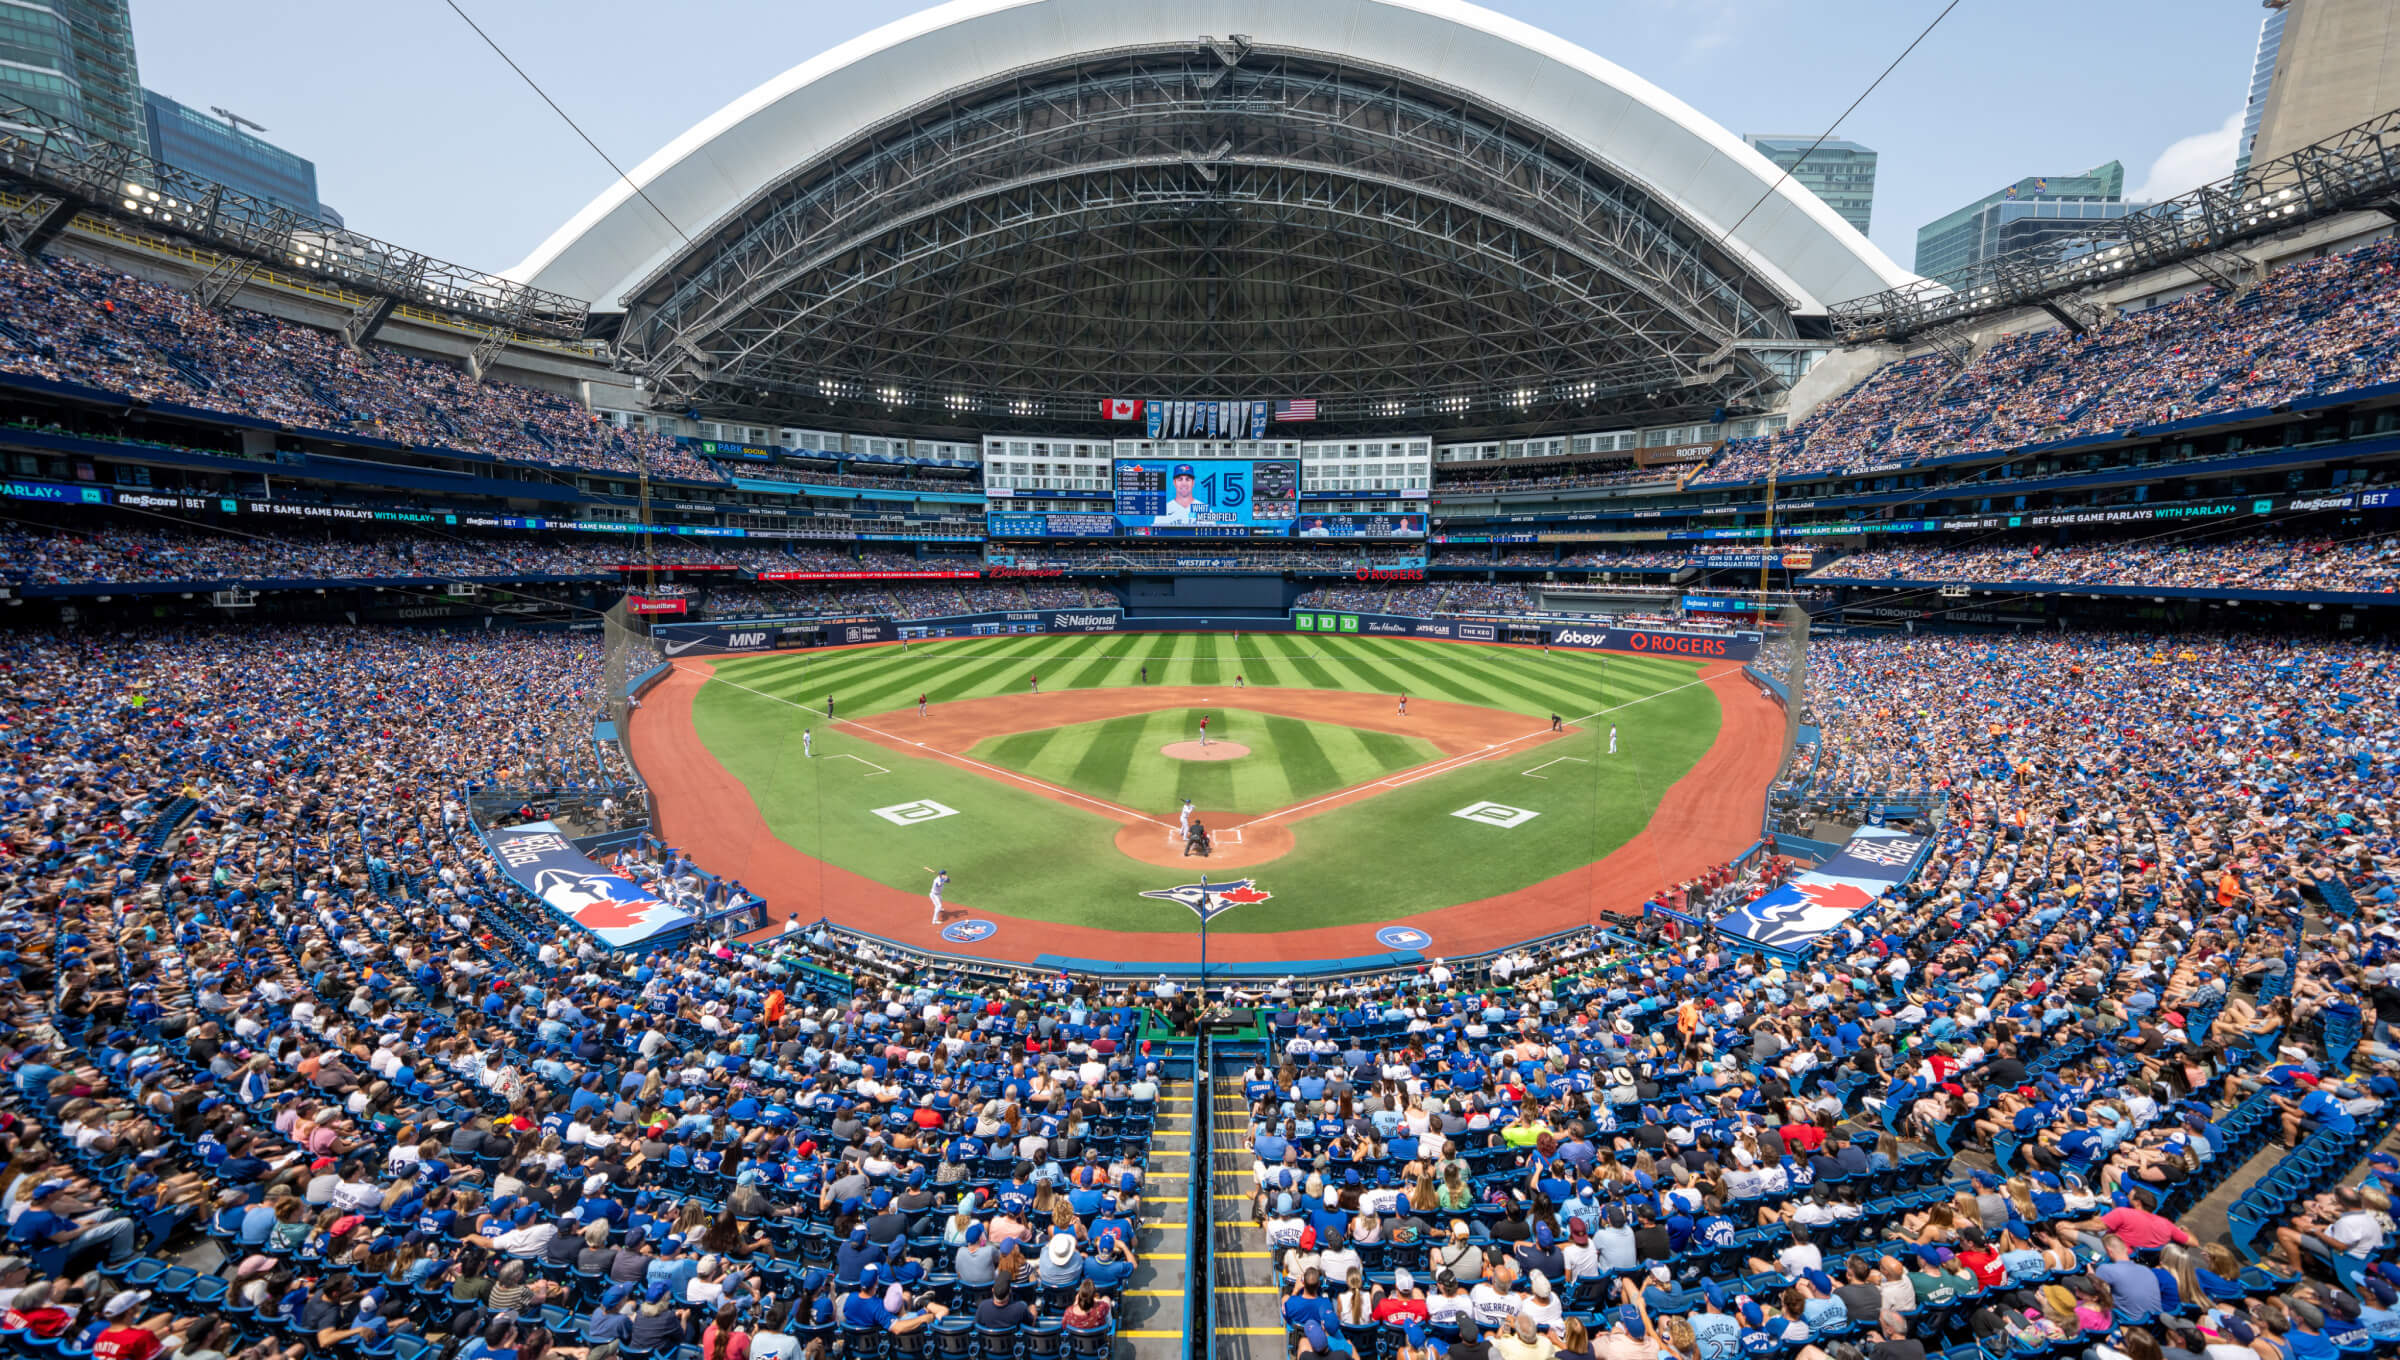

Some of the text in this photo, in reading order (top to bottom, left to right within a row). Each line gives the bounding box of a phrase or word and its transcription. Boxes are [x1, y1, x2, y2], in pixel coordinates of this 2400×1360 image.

[718, 443, 742, 452] PARK
[743, 448, 768, 456] SOCIAL
[1676, 446, 1713, 457] ROOFTOP
[1870, 463, 1902, 472] ROBINSON
[0, 484, 62, 498] ARLAY+
[1200, 472, 1245, 507] 15
[119, 494, 206, 509] theScore BET
[2290, 493, 2389, 511] theScore BET
[251, 503, 436, 522] BET SAME GAME PARLAYS WITH PARLAY+
[1192, 504, 1209, 513] WHIT
[2032, 503, 2237, 525] BET SAME GAME PARLAYS WITH PARLAY+
[466, 517, 499, 526] theScore
[1197, 513, 1237, 521] MERRIFIELD
[559, 521, 577, 529] SAME
[578, 522, 597, 530] GAME
[1944, 519, 1998, 529] theScore BET
[1177, 559, 1212, 567] WESTJET
[989, 565, 1063, 578] Budweiser
[1371, 569, 1423, 580] ROGERS
[1712, 600, 1725, 608] BET
[399, 606, 450, 618] EQUALITY
[1875, 608, 1921, 618] TORONTO
[1946, 612, 1993, 623] BLUE JAYS
[1069, 614, 1116, 626] National
[1300, 616, 1313, 628] TD
[1320, 617, 1335, 629] TD
[1342, 618, 1357, 629] TD
[1368, 622, 1406, 632] Tim Hortons
[1434, 625, 1449, 633] CARE
[728, 632, 766, 647] MNP
[1555, 629, 1606, 646] Sobeys
[1651, 635, 1726, 655] ROGERS
[1382, 1116, 1396, 1124] KIRK
[1035, 1168, 1049, 1178] KIRK
[1574, 1206, 1600, 1217] BICHETTE
[1274, 1228, 1302, 1240] BICHETTE
[1480, 1302, 1514, 1313] GUERRERO
[1709, 1340, 1737, 1360] 27
